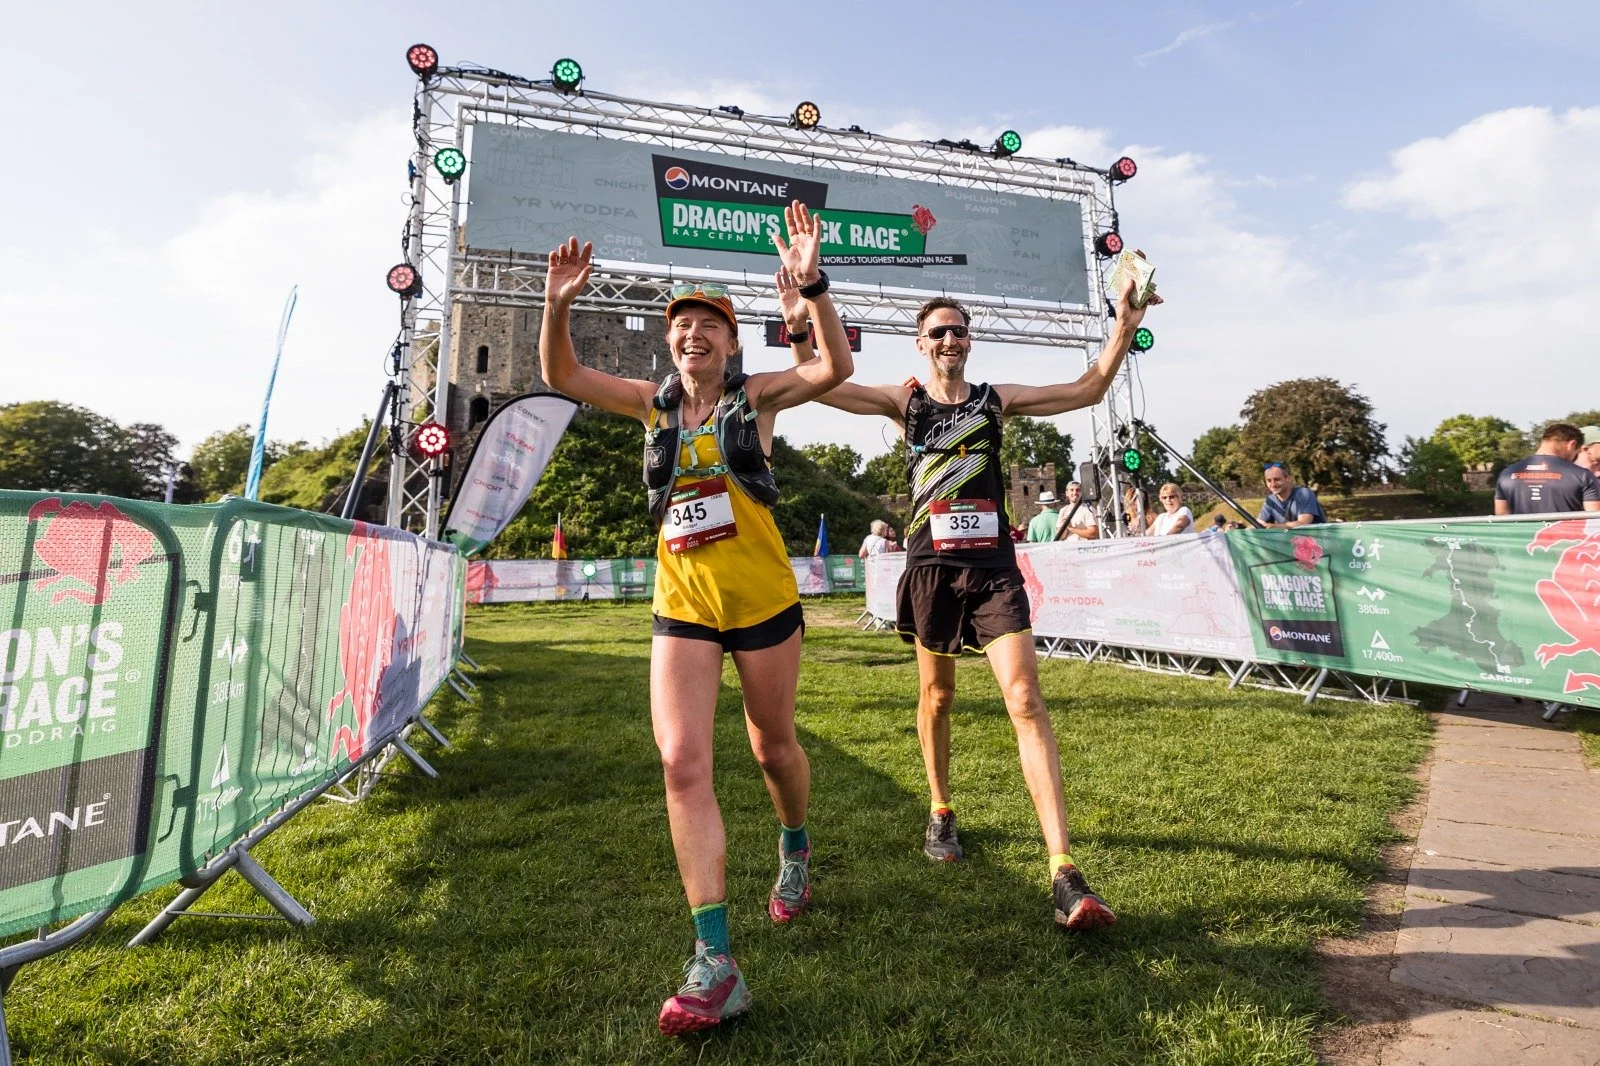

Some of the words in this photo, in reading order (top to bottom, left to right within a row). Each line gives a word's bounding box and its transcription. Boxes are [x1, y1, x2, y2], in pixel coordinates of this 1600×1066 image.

[593, 178, 648, 192] CNICHT
[945, 190, 1017, 207] PUMLUMON
[512, 196, 542, 209] YR
[549, 200, 639, 219] WYDDFA
[964, 204, 999, 216] FAWR
[673, 202, 781, 237] DRAGON'S
[819, 221, 843, 245] CK
[604, 233, 644, 247] CRIB
[672, 228, 699, 237] RAS
[708, 231, 743, 242] CEFN
[1011, 227, 1039, 239] PEN
[600, 246, 648, 260] GOCH
[820, 256, 856, 264] WORLD'S
[857, 256, 895, 264] TOUGHEST
[896, 256, 934, 264] MOUNTAIN
[936, 256, 953, 264] RACE
[1013, 250, 1040, 261] FAN
[922, 270, 976, 283] DRYGARN
[994, 282, 1048, 294] CARDIFF
[517, 405, 546, 423] CONWY
[473, 478, 503, 492] CNICHT
[672, 502, 707, 526] 345
[949, 515, 980, 530] 352
[228, 519, 243, 564] 6
[1352, 539, 1366, 558] 6
[1137, 559, 1157, 568] FAN
[1349, 560, 1372, 571] days
[219, 569, 244, 590] days
[1261, 574, 1322, 593] DRAGON'S
[1064, 597, 1104, 606] WYDDFA
[1263, 591, 1293, 606] BACK
[1294, 592, 1325, 608] RACE
[1358, 604, 1390, 615] 380km
[1115, 618, 1160, 628] DRYGARN
[1135, 627, 1162, 637] FAWR
[1479, 672, 1533, 685] CARDIFF
[212, 680, 245, 704] 380km
[5, 719, 118, 749] DDRAIG
